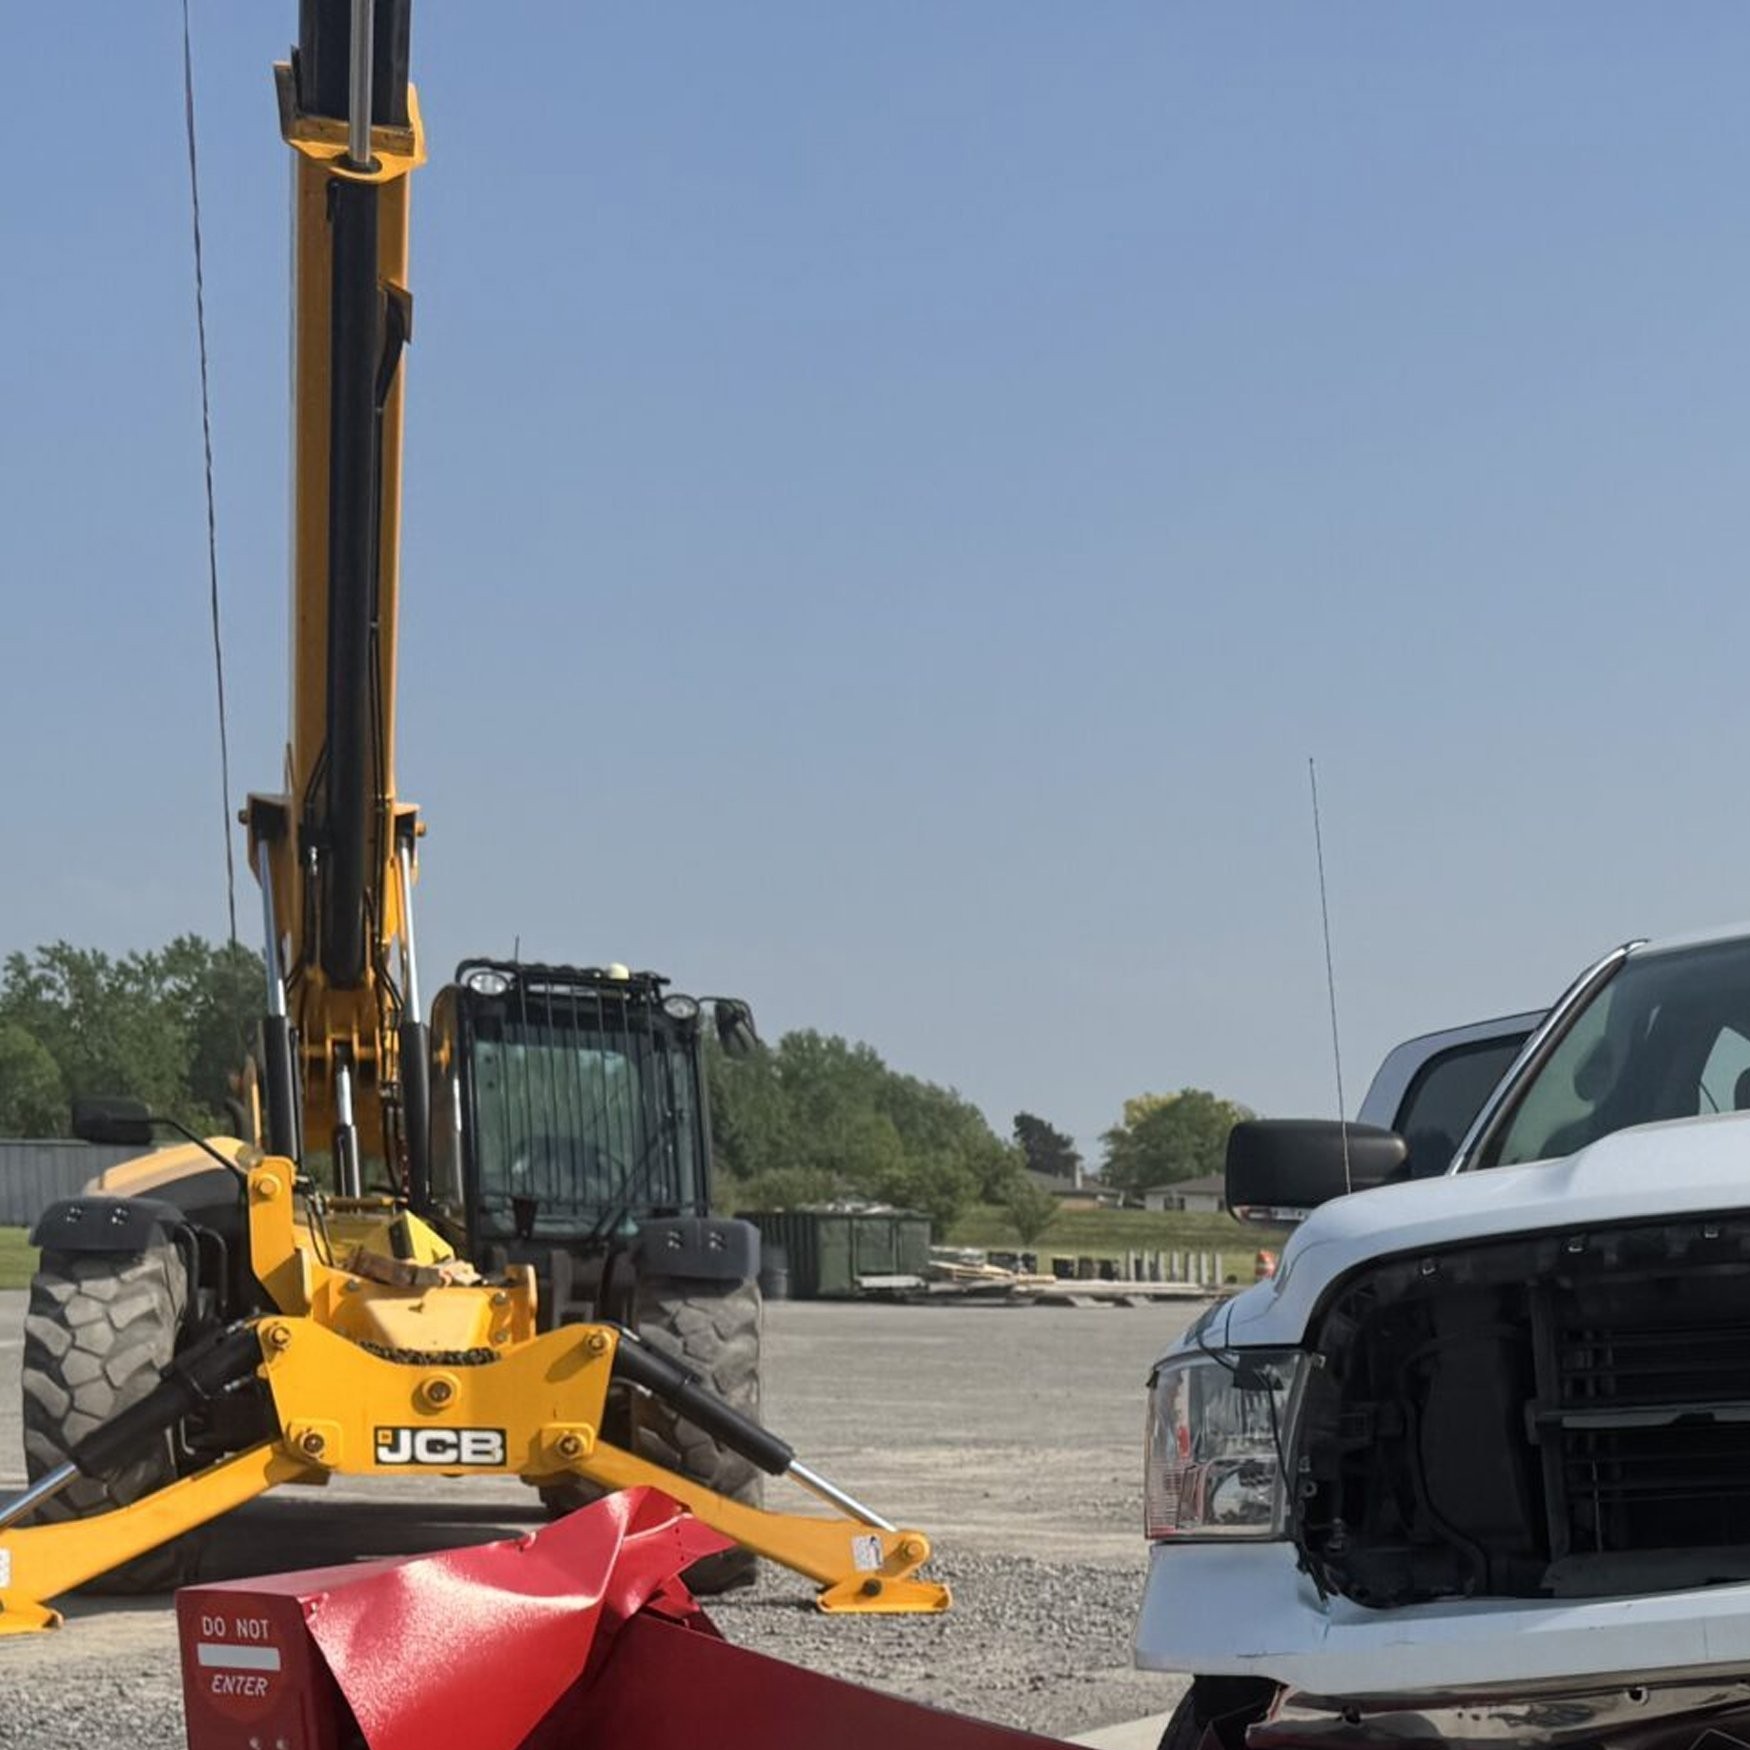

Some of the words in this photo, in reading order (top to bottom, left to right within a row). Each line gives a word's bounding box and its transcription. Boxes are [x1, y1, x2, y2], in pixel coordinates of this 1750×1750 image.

[377, 1429, 504, 1464] JCB
[202, 1616, 226, 1637] DO
[236, 1619, 269, 1640] NOT
[211, 1674, 269, 1697] ENTER
